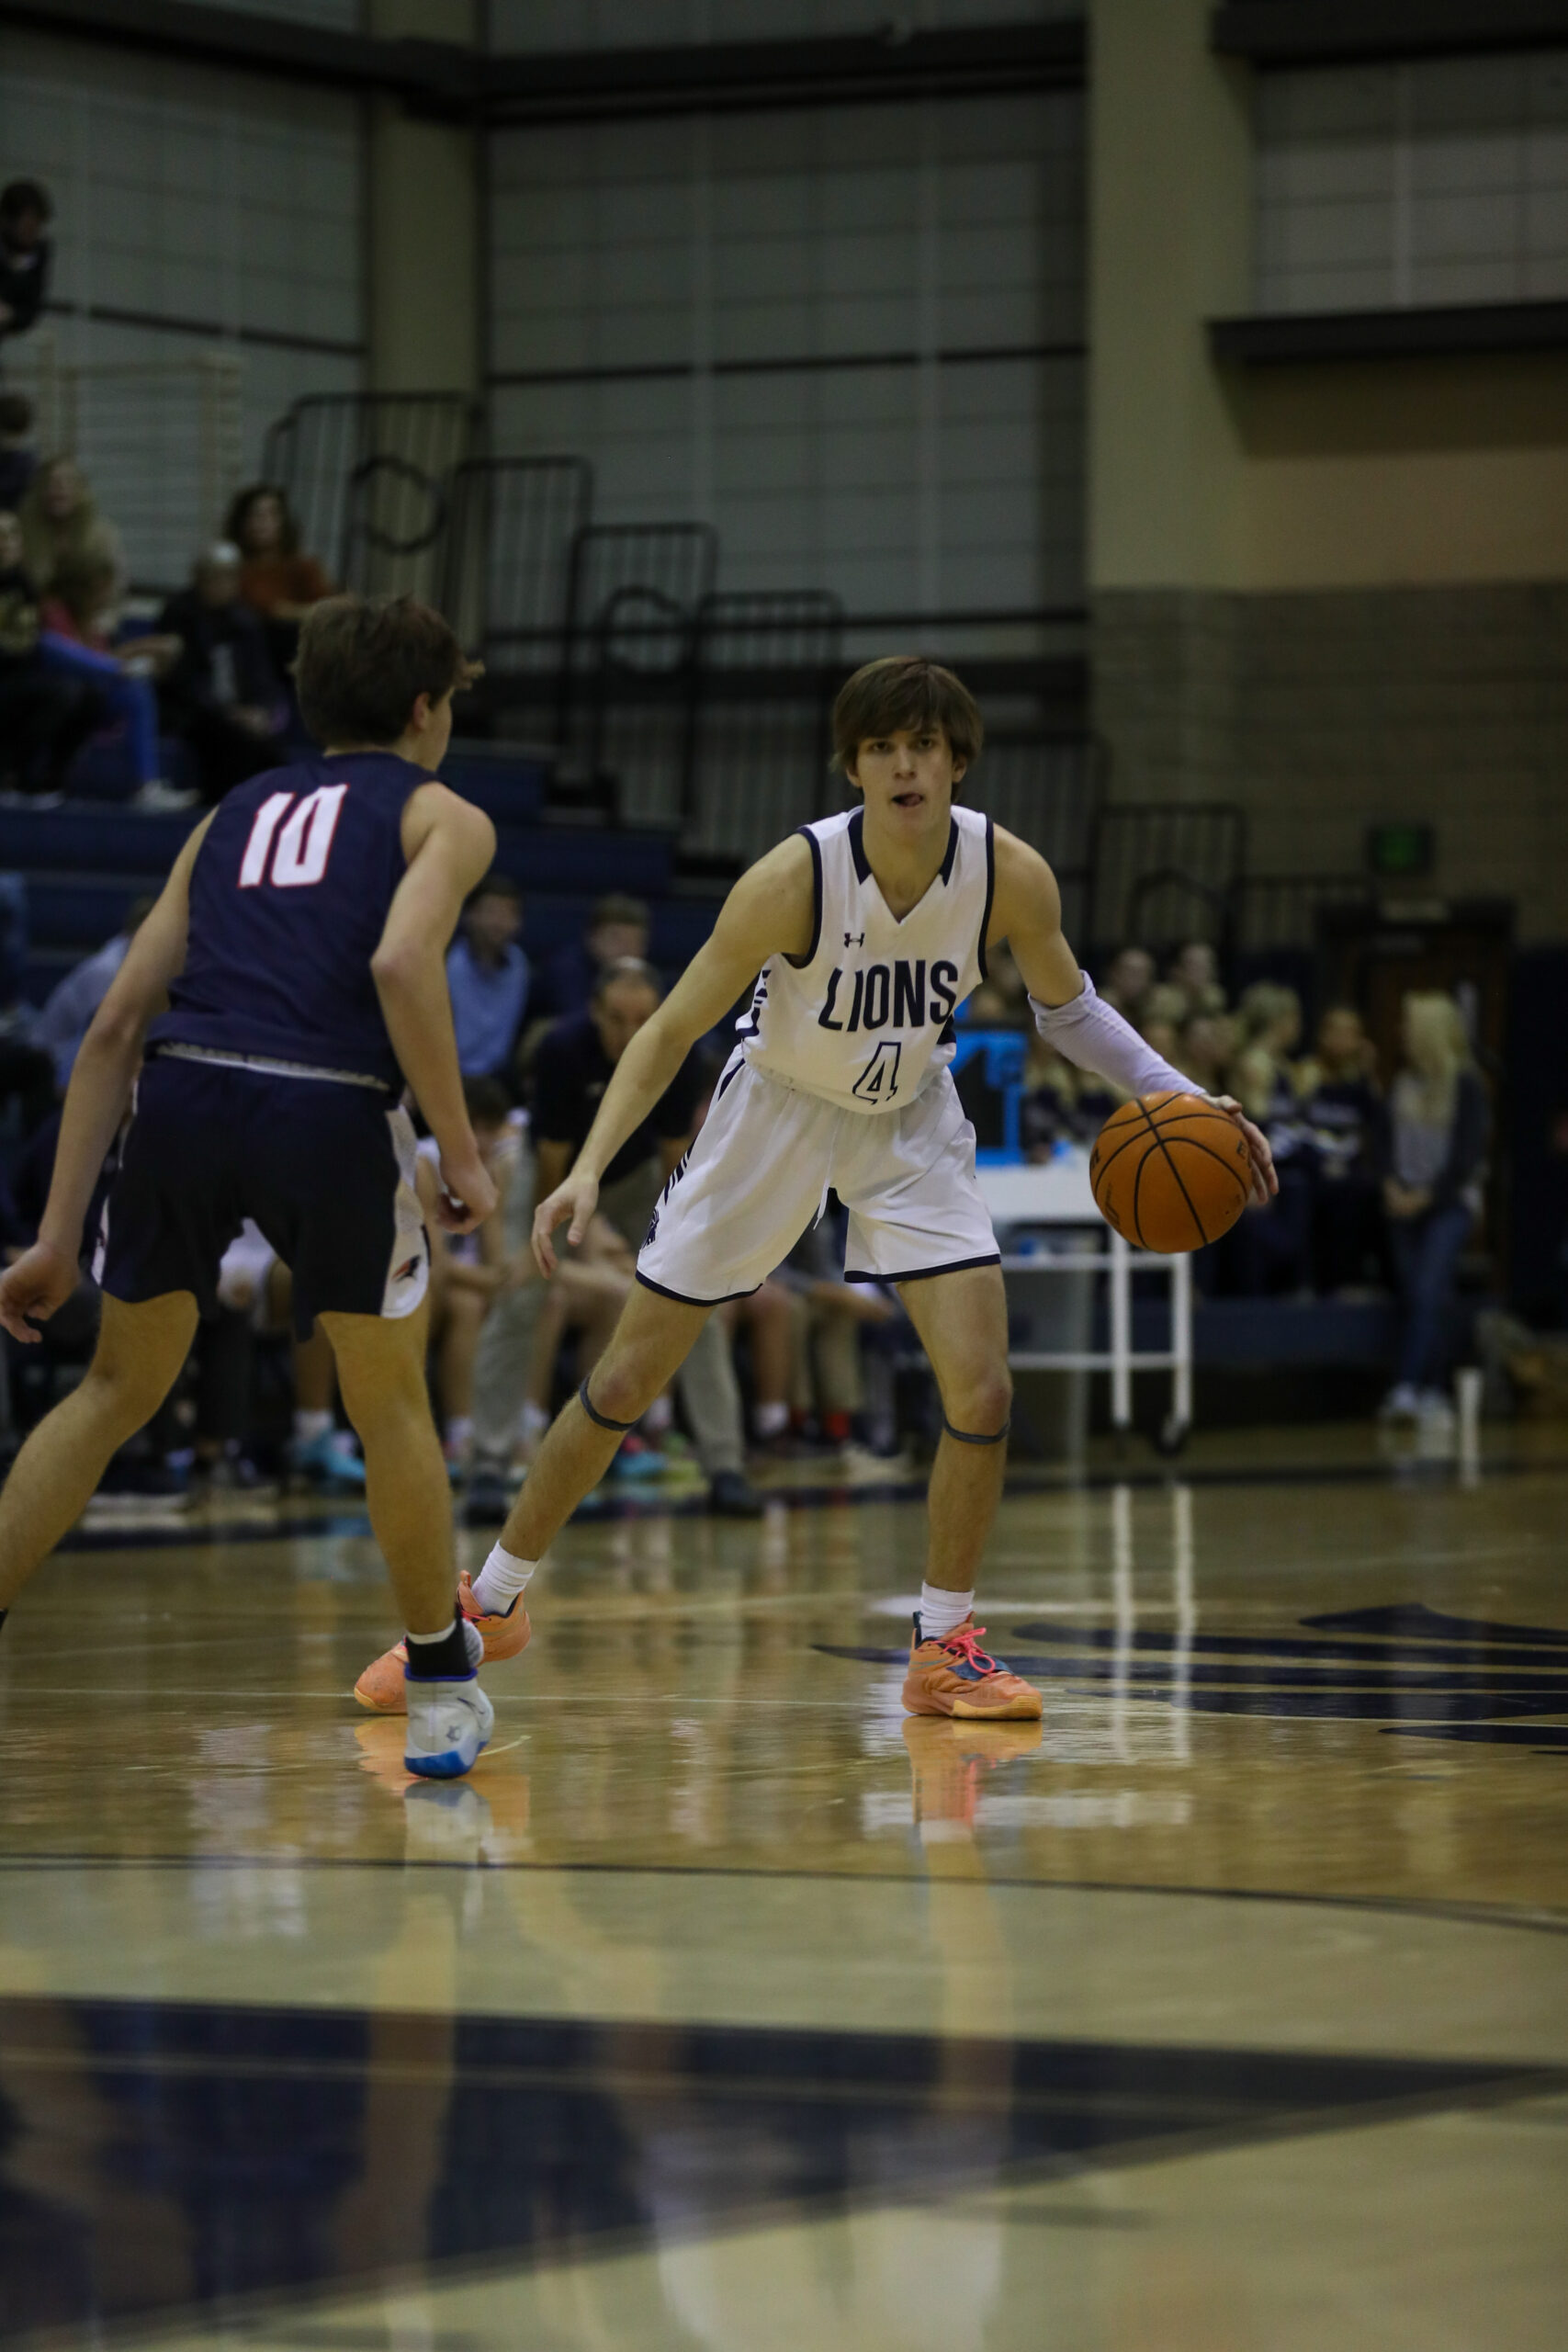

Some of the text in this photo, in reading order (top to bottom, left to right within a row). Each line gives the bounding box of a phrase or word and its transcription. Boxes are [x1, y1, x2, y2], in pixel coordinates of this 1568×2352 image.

[237, 783, 350, 888] 10
[818, 959, 958, 1032] LIONS
[852, 1042, 901, 1104] 4
